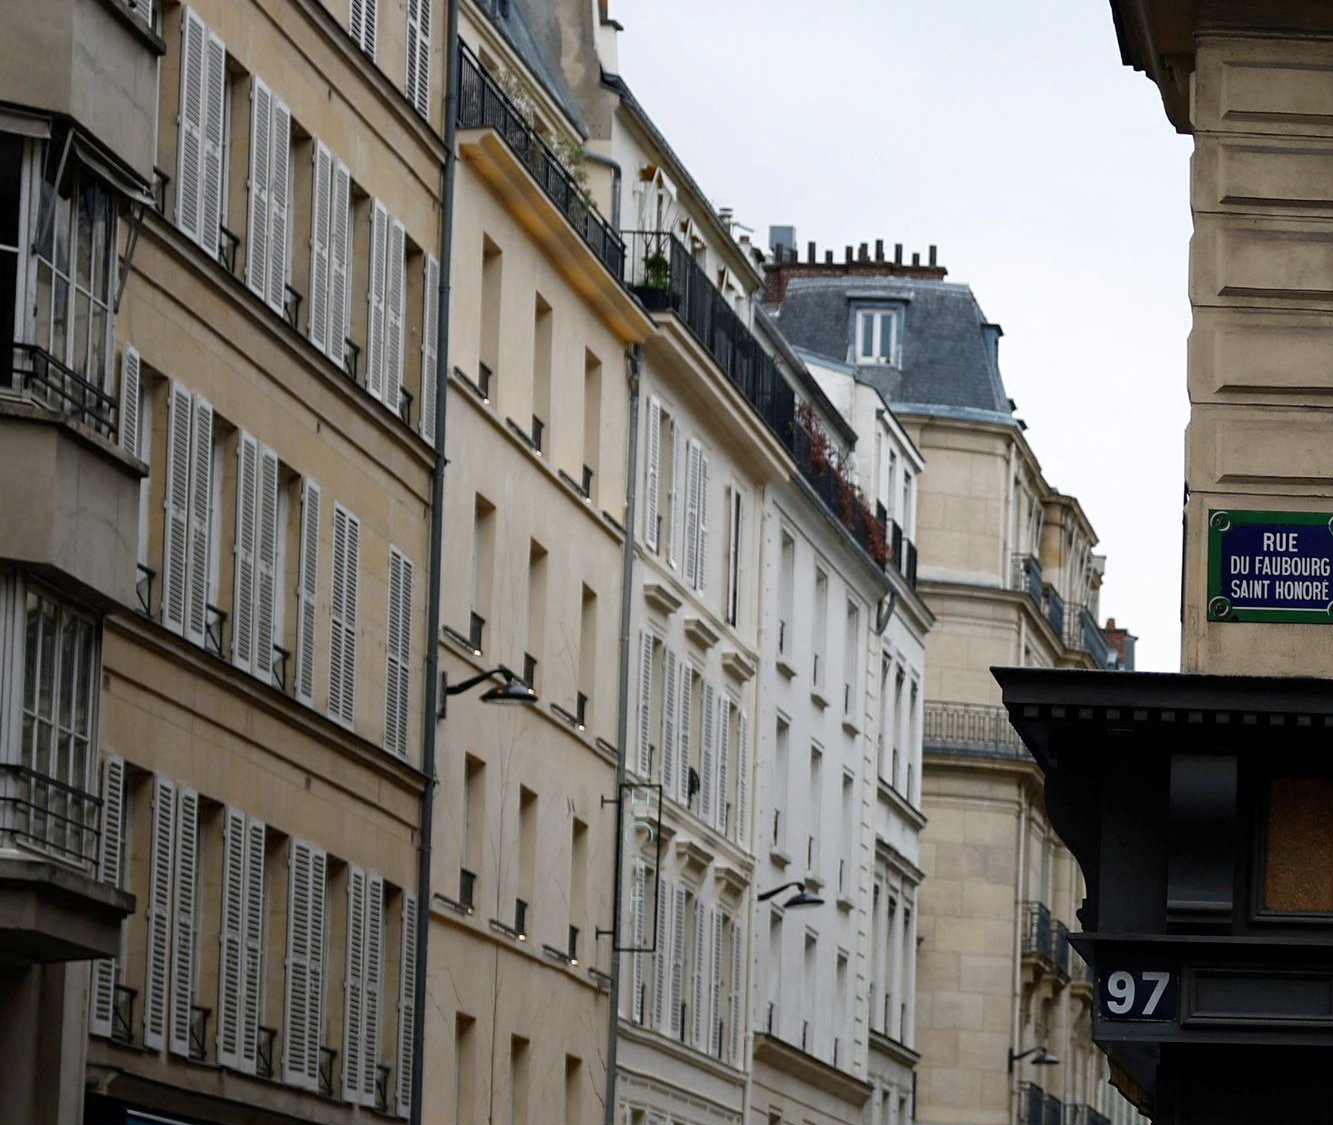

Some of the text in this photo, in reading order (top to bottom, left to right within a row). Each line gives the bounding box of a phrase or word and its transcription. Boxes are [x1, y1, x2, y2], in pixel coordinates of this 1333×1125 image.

[1263, 533, 1299, 552] RUE
[1230, 555, 1331, 577] DU FAUBOURG
[1231, 579, 1330, 601] SAINT HONORÉ
[1105, 970, 1173, 1016] 97
